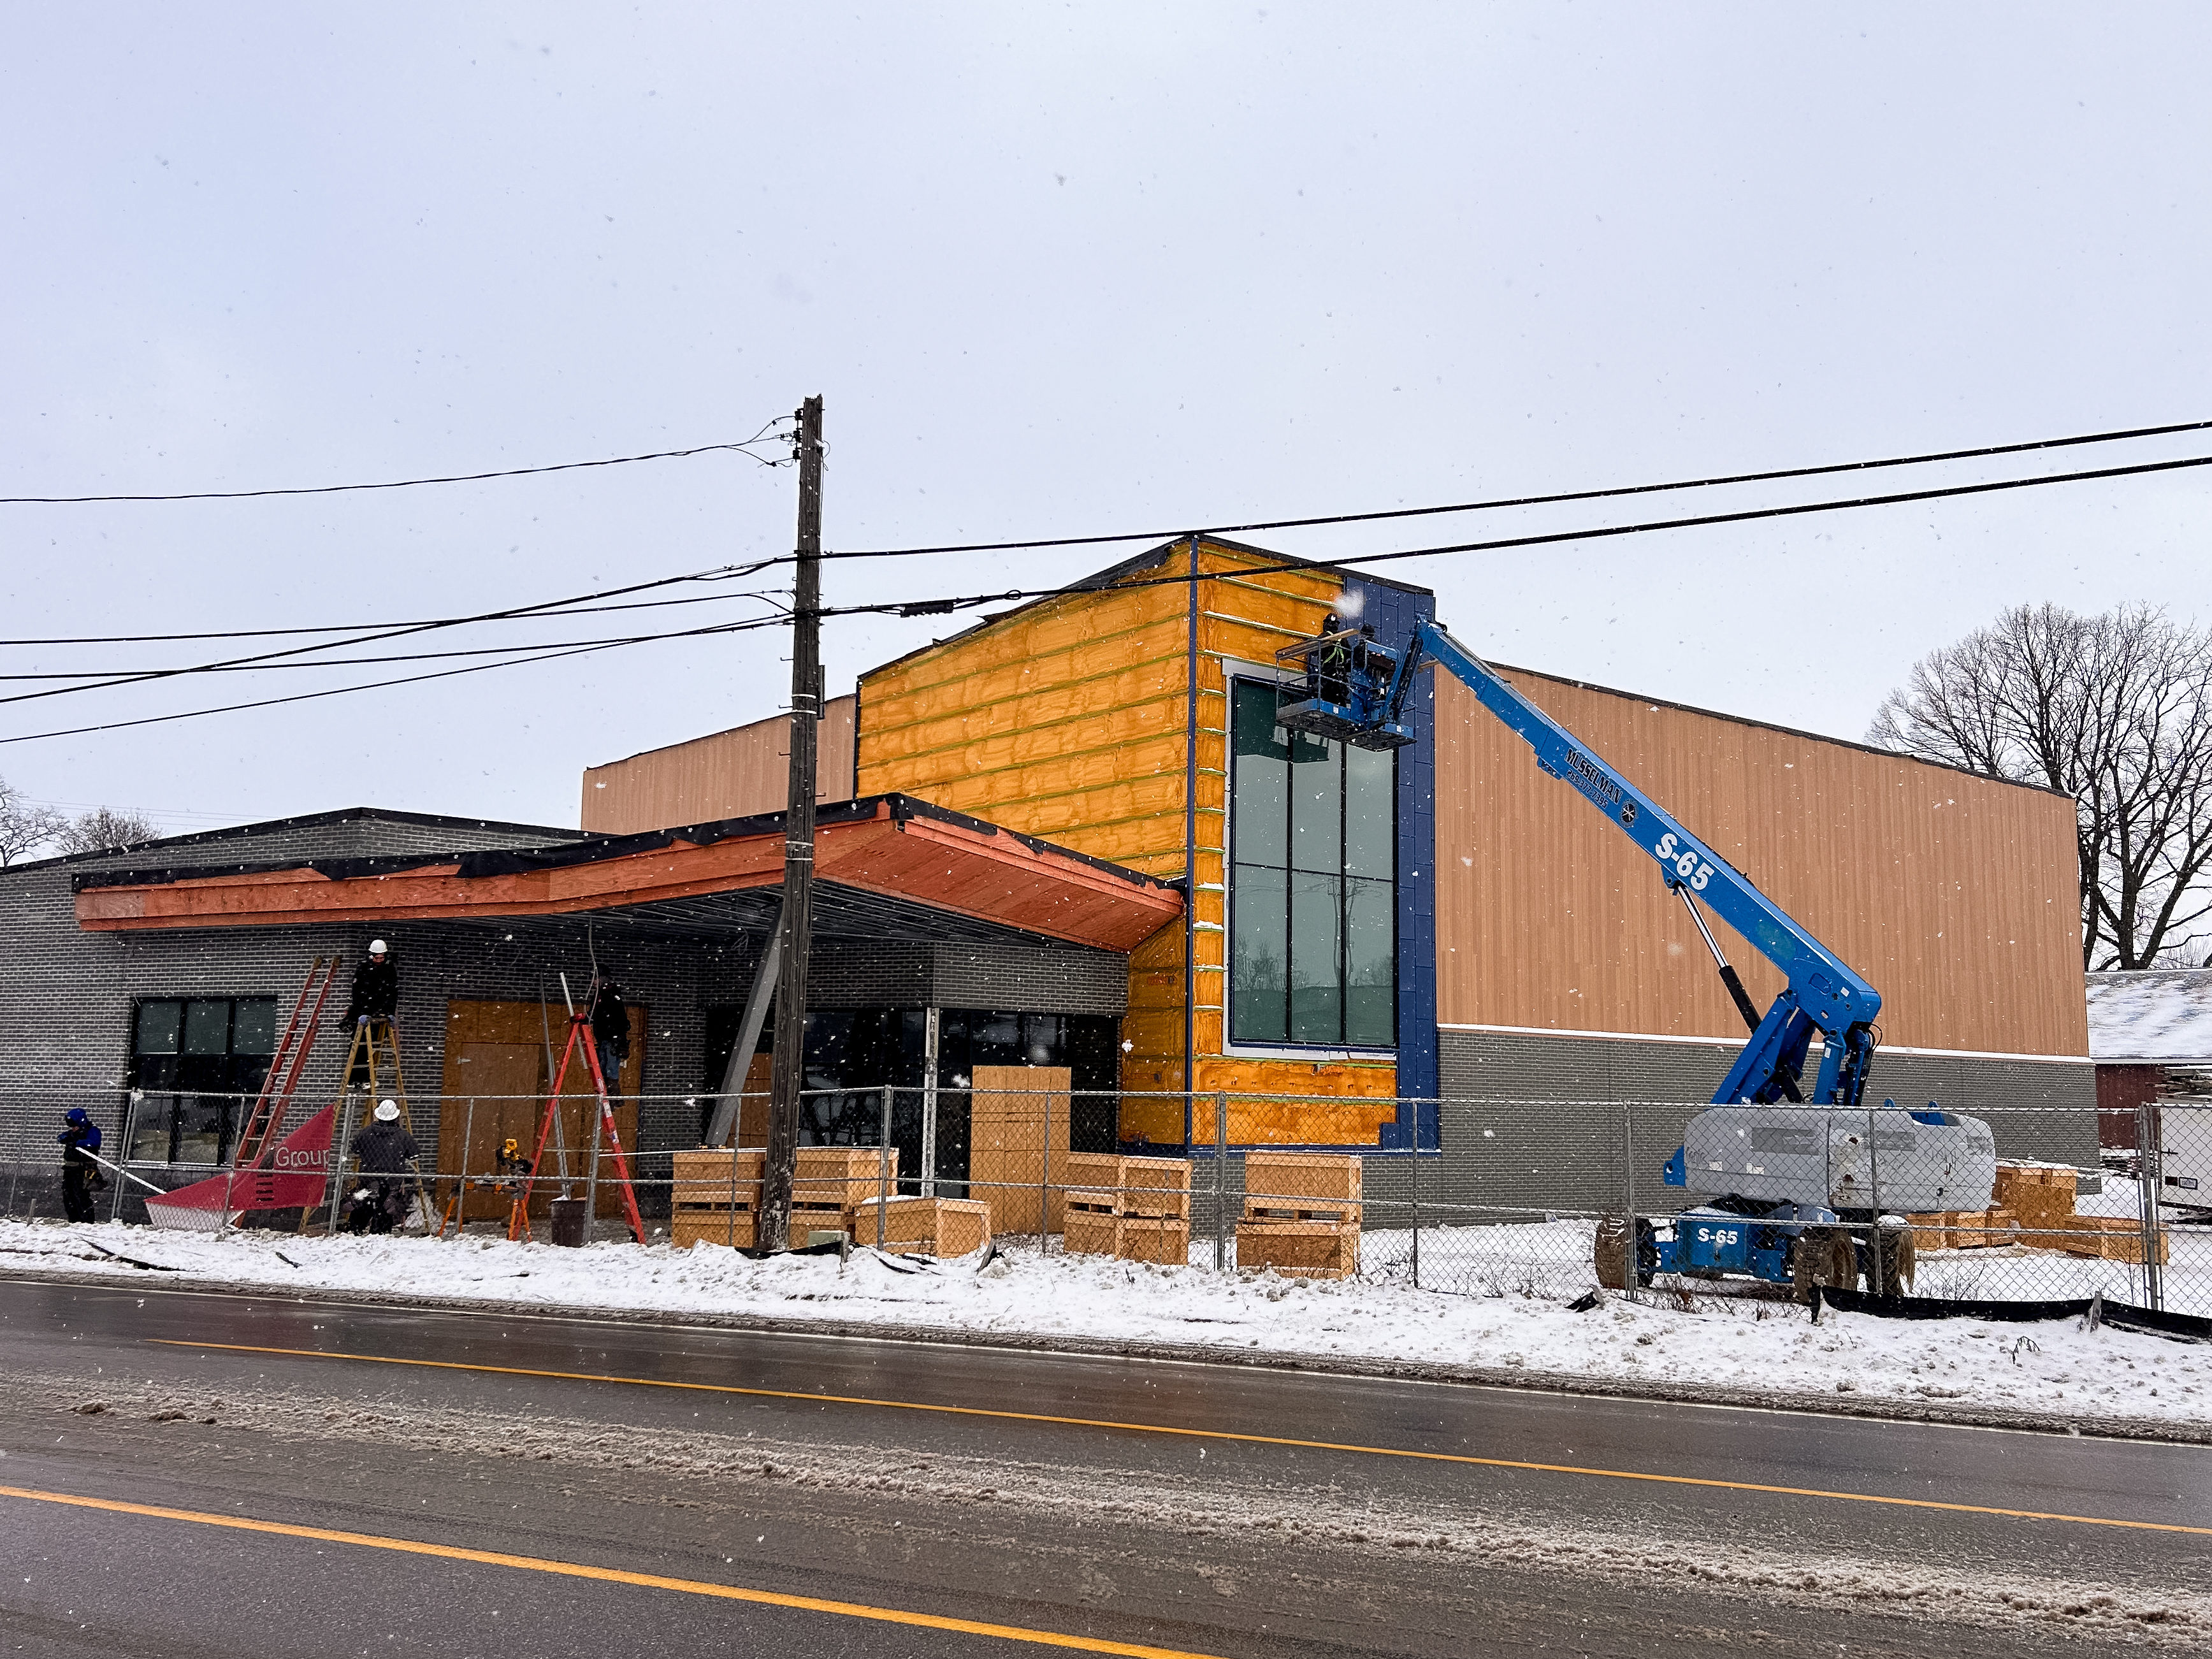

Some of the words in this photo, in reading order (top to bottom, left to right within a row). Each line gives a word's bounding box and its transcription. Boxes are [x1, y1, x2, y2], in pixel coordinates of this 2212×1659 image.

[1564, 748, 1623, 805] MUSSELMAN
[1655, 832, 1715, 890] S-65
[275, 1147, 330, 1168] Group
[1697, 1228, 1738, 1245] S-65
